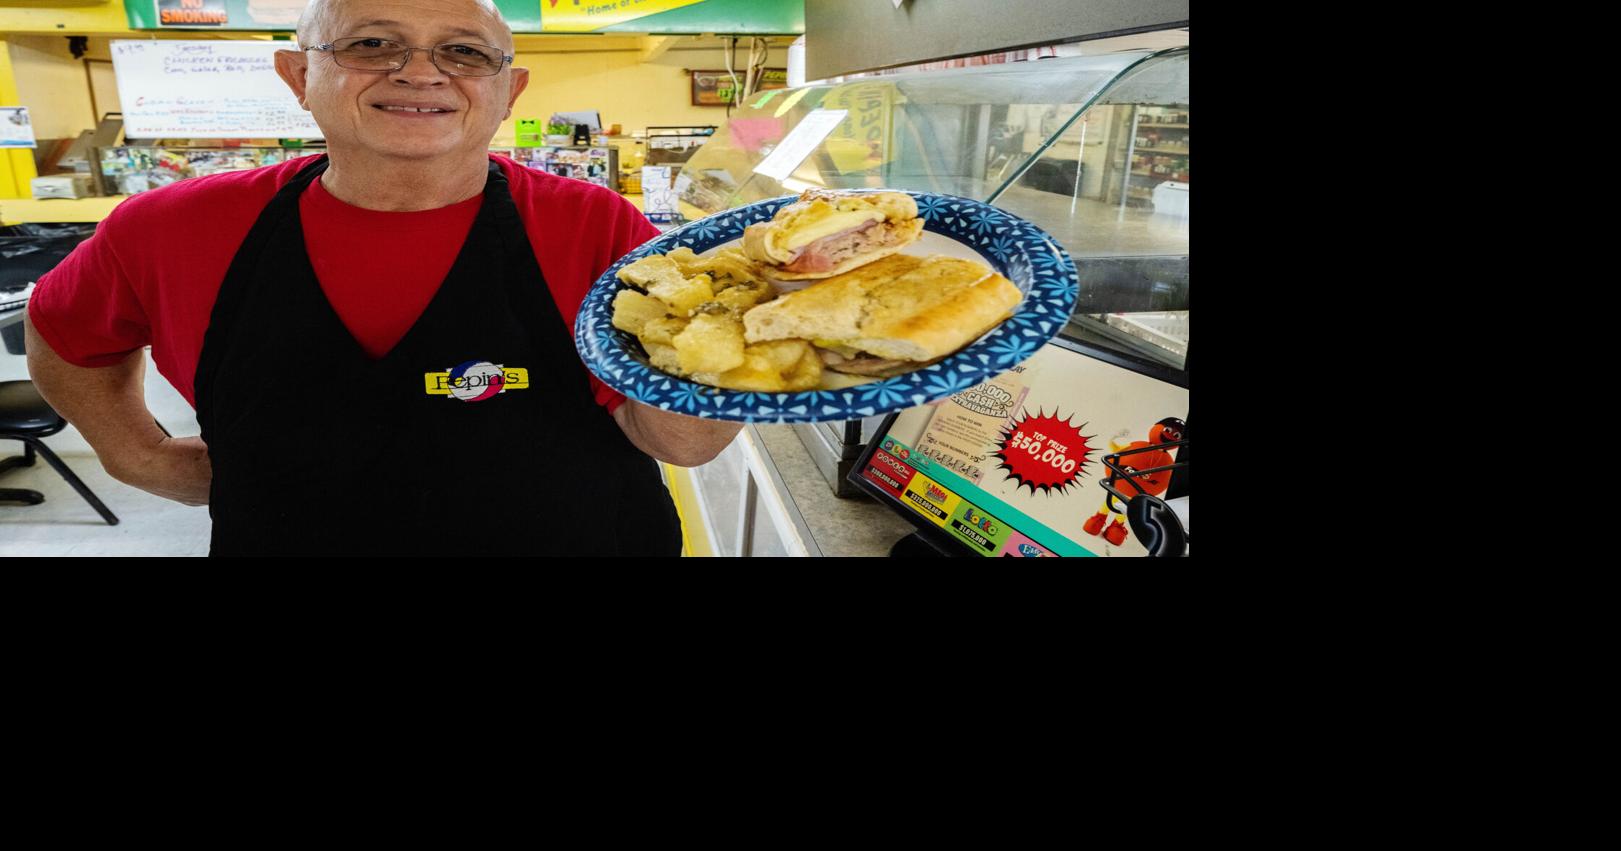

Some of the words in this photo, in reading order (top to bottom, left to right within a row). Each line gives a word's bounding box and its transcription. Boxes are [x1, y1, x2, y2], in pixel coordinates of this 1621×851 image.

[160, 9, 228, 23] SMOKING
[434, 371, 521, 391] Pepin's
[966, 391, 995, 409] CASH
[975, 383, 1012, 403] 0,000
[1011, 431, 1076, 473] $50,000
[1033, 431, 1048, 442] TOP
[1047, 439, 1068, 454] PRIZE
[964, 508, 998, 536] Lotto
